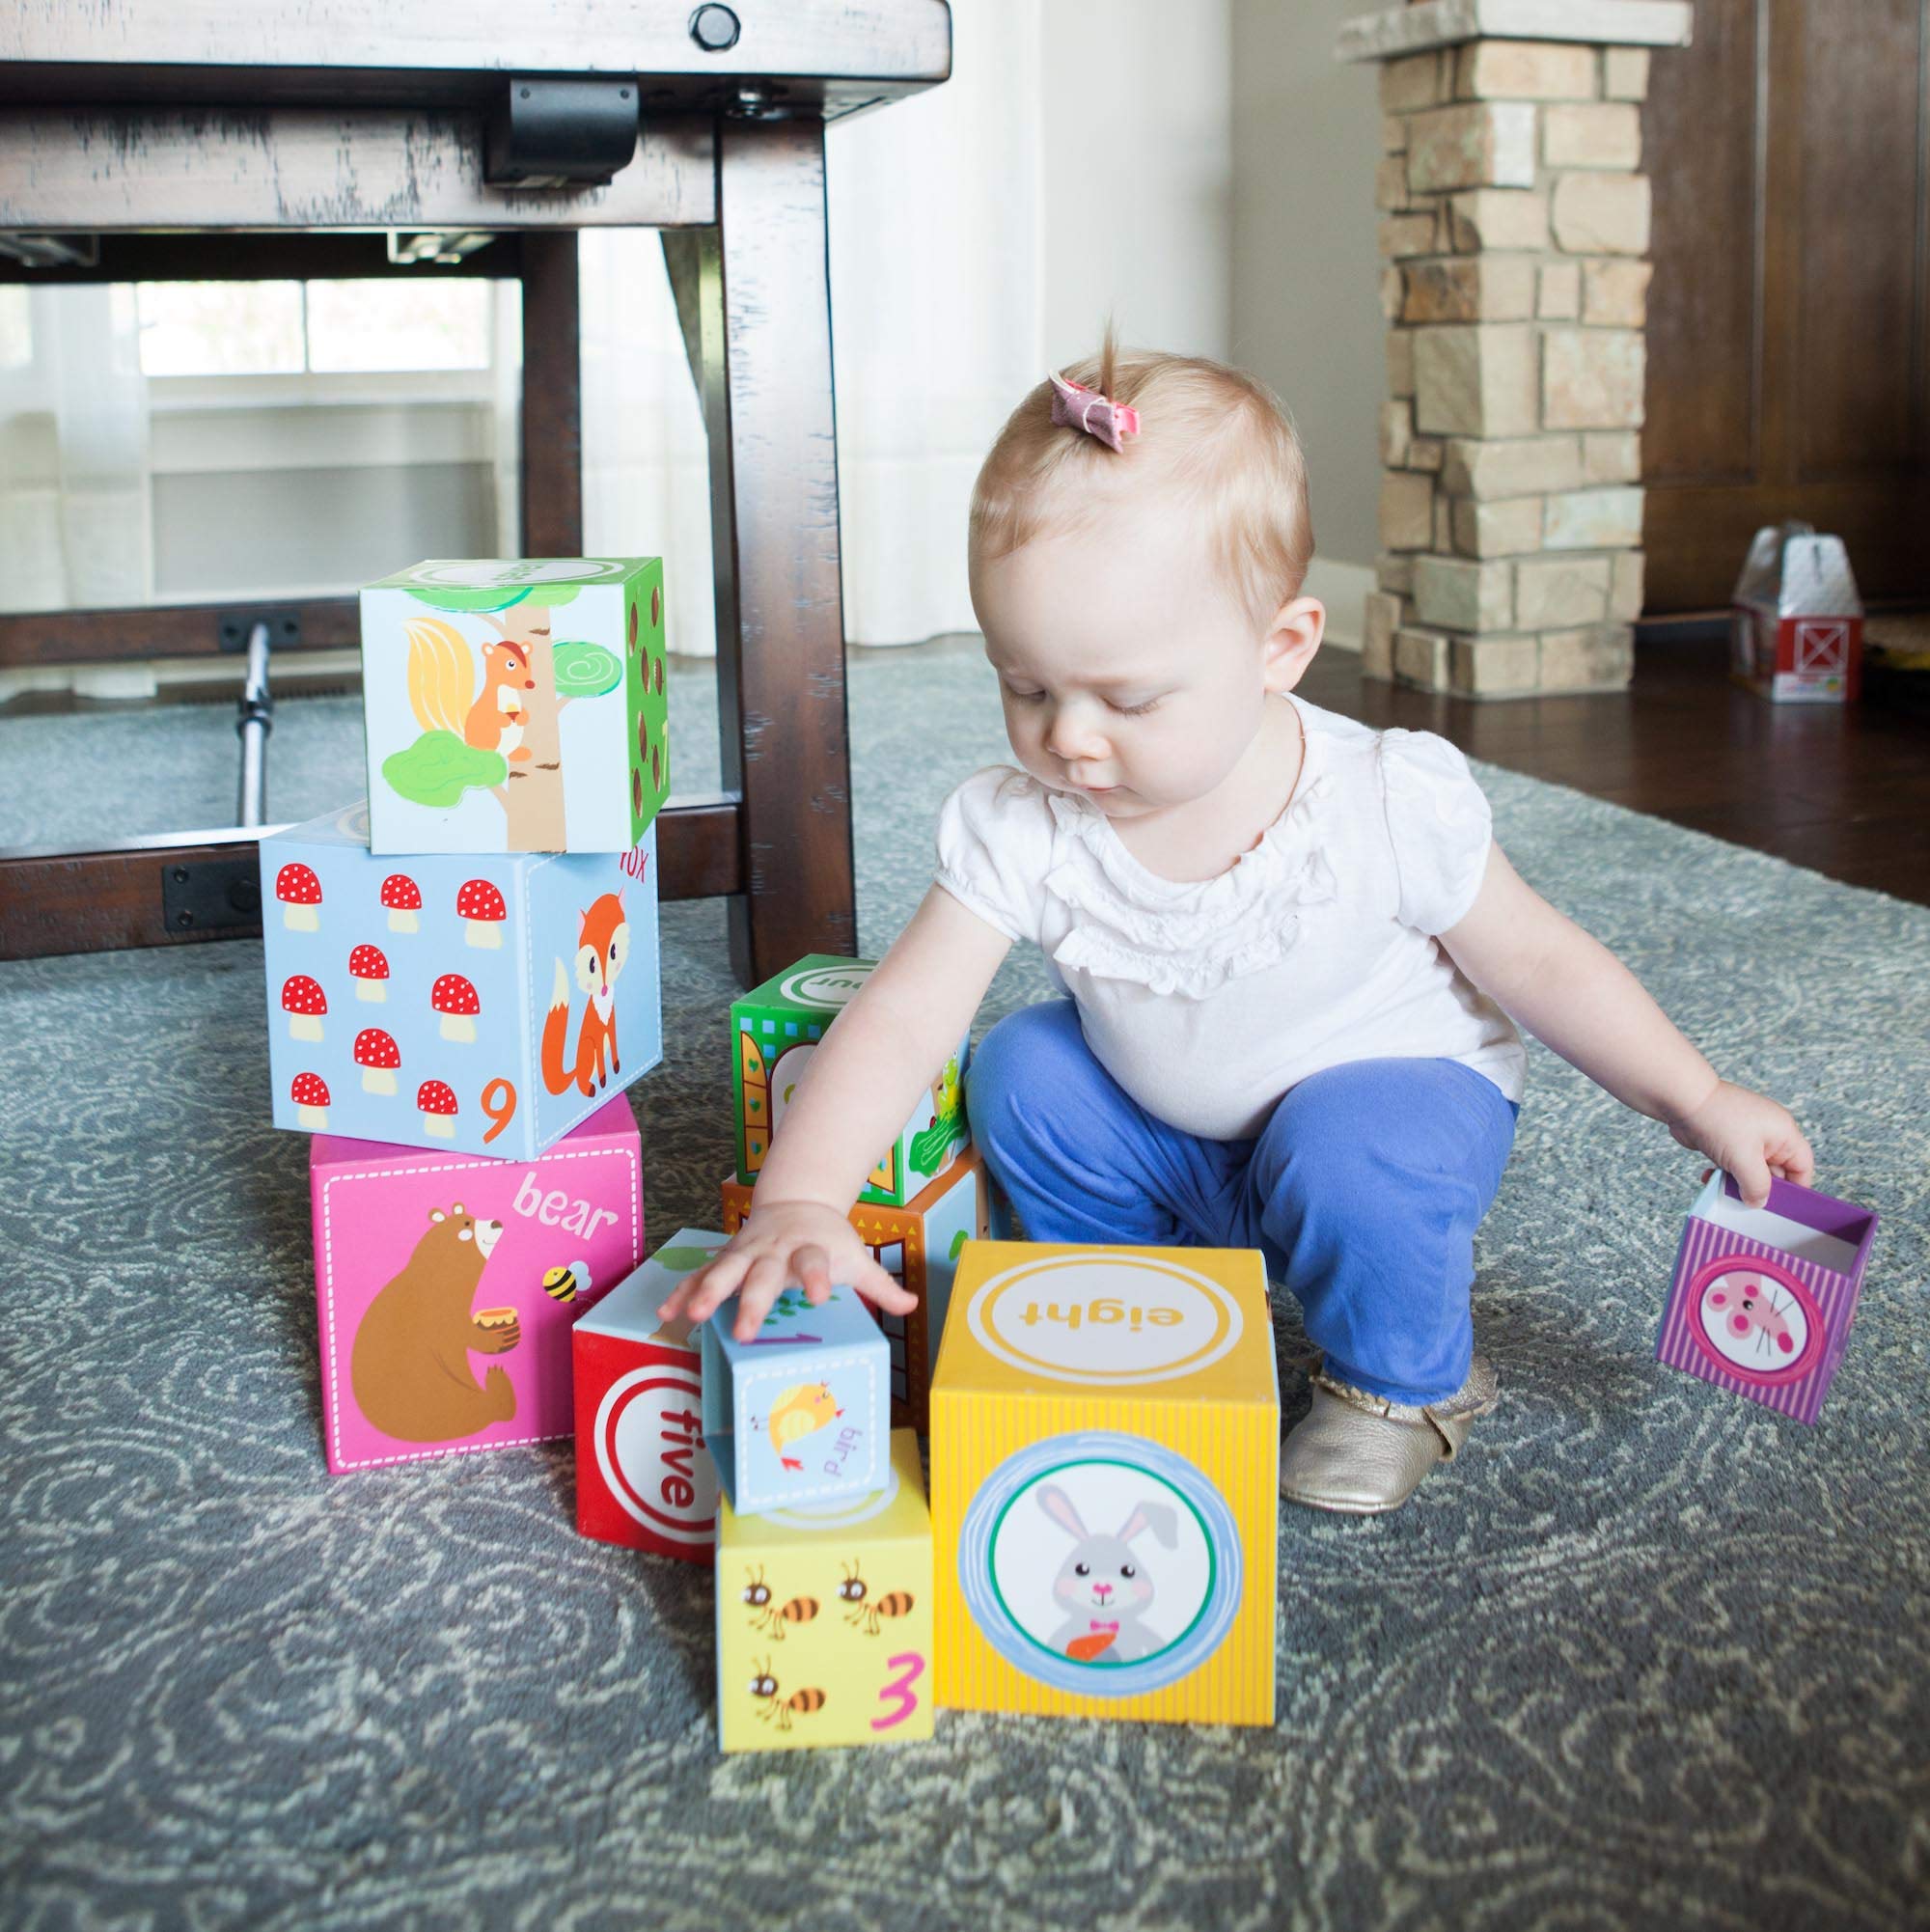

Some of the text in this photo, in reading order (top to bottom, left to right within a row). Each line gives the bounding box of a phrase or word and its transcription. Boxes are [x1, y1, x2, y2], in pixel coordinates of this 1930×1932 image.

[481, 1077, 517, 1145] 9
[512, 1171, 619, 1241] bear
[1019, 1298, 1184, 1333] eight
[660, 1409, 706, 1508] five
[823, 1427, 864, 1477] bird
[870, 1651, 925, 1731] 3
